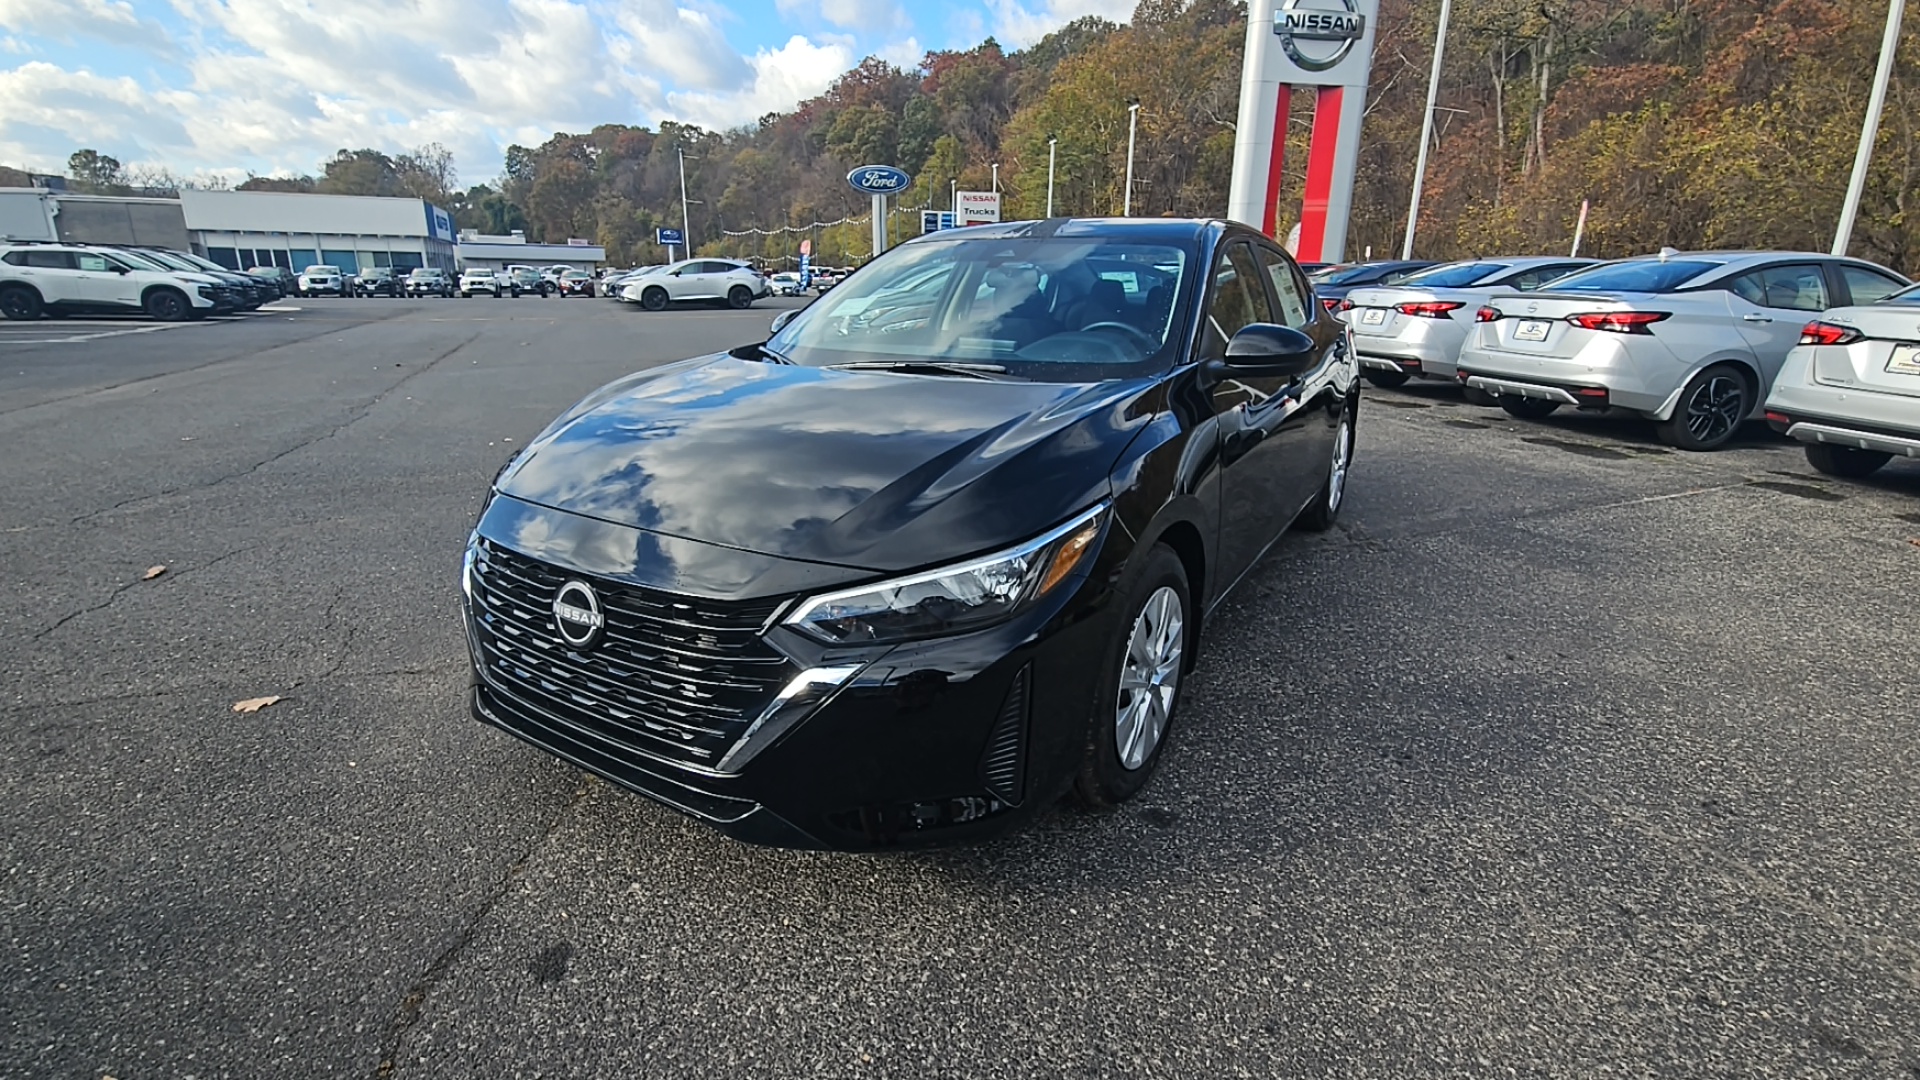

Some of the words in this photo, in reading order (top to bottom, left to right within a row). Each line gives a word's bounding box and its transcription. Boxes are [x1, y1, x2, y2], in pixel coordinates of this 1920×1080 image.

[1285, 14, 1358, 31] NISSAN
[862, 171, 898, 188] Ford
[964, 208, 995, 216] Trucks
[555, 603, 601, 626] NISSAN
